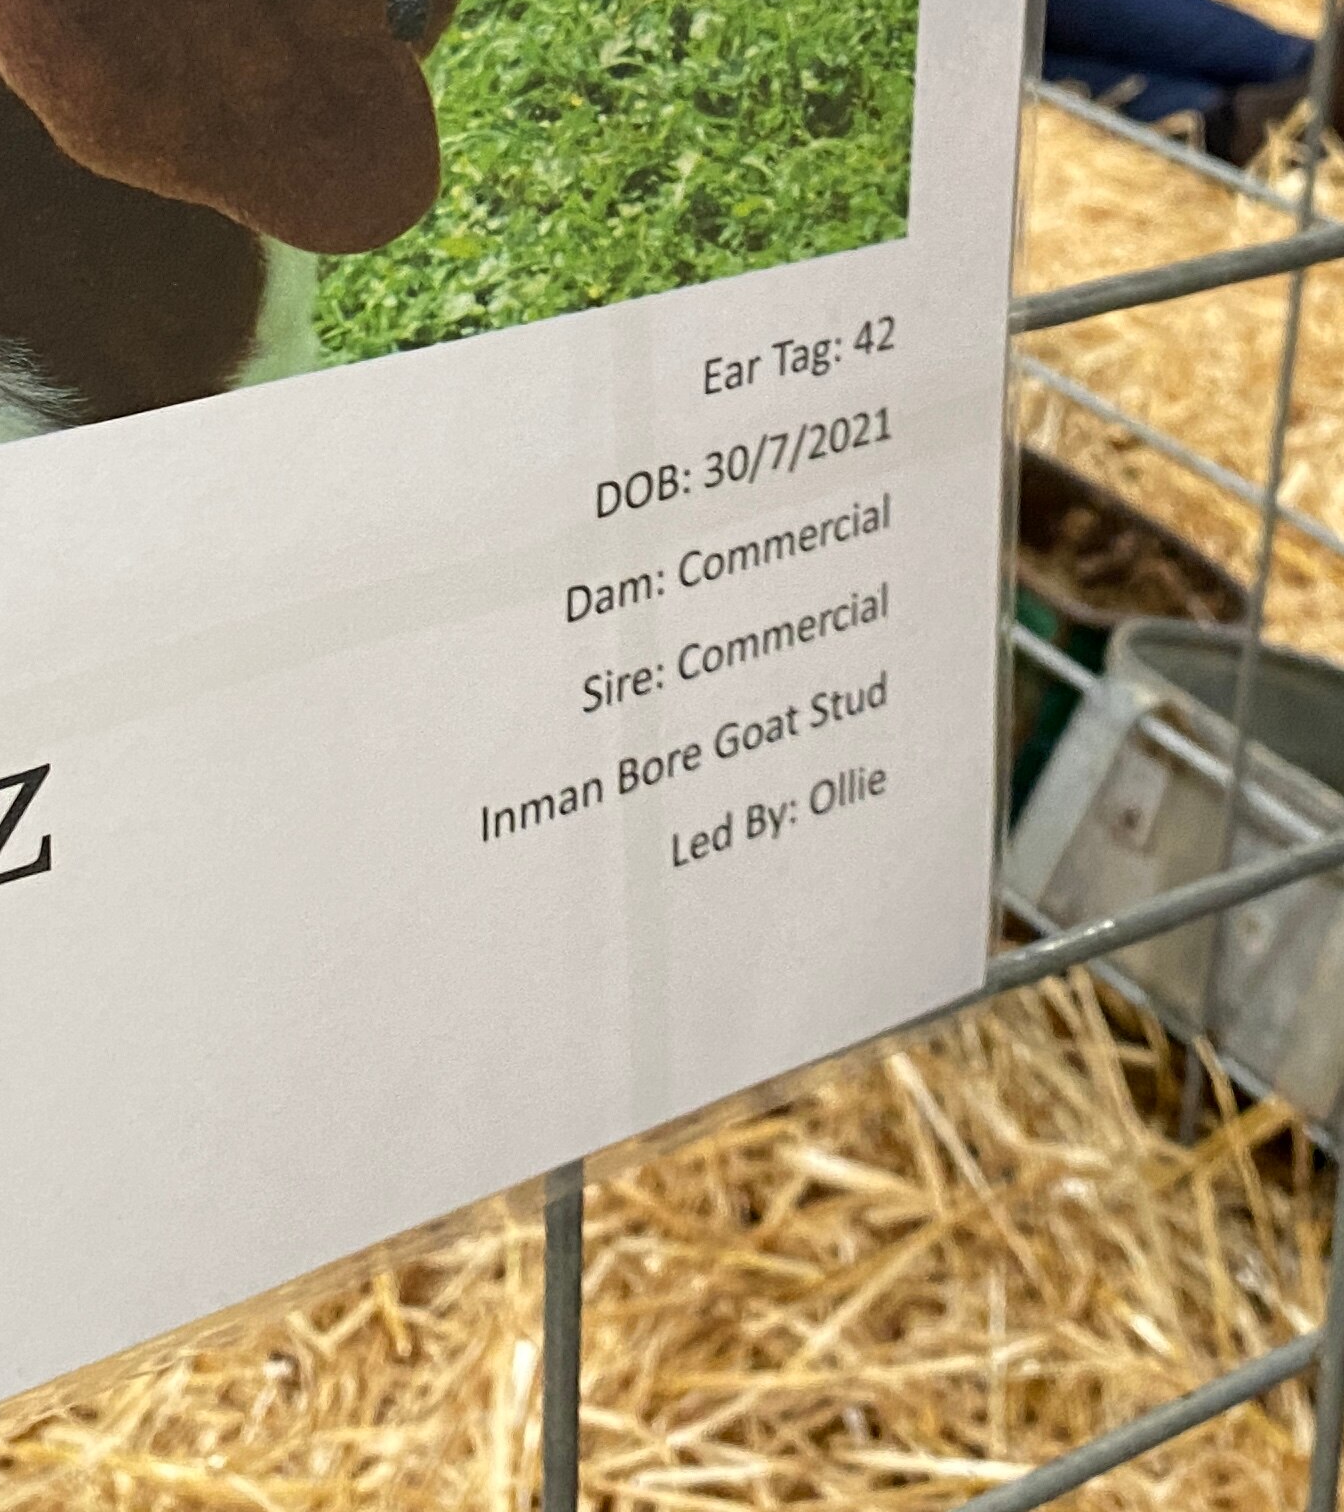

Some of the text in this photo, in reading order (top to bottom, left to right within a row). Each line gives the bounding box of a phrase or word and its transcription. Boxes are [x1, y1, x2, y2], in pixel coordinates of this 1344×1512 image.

[704, 315, 895, 395] Ear Tag: 42
[596, 407, 891, 519] DOB: 30/7/2021
[566, 492, 890, 623] Dam: Commercial
[583, 582, 888, 713] Sire: Commercial
[482, 670, 887, 843] Inman Bore Goat Stud
[672, 769, 886, 868] Led By: Ollie
